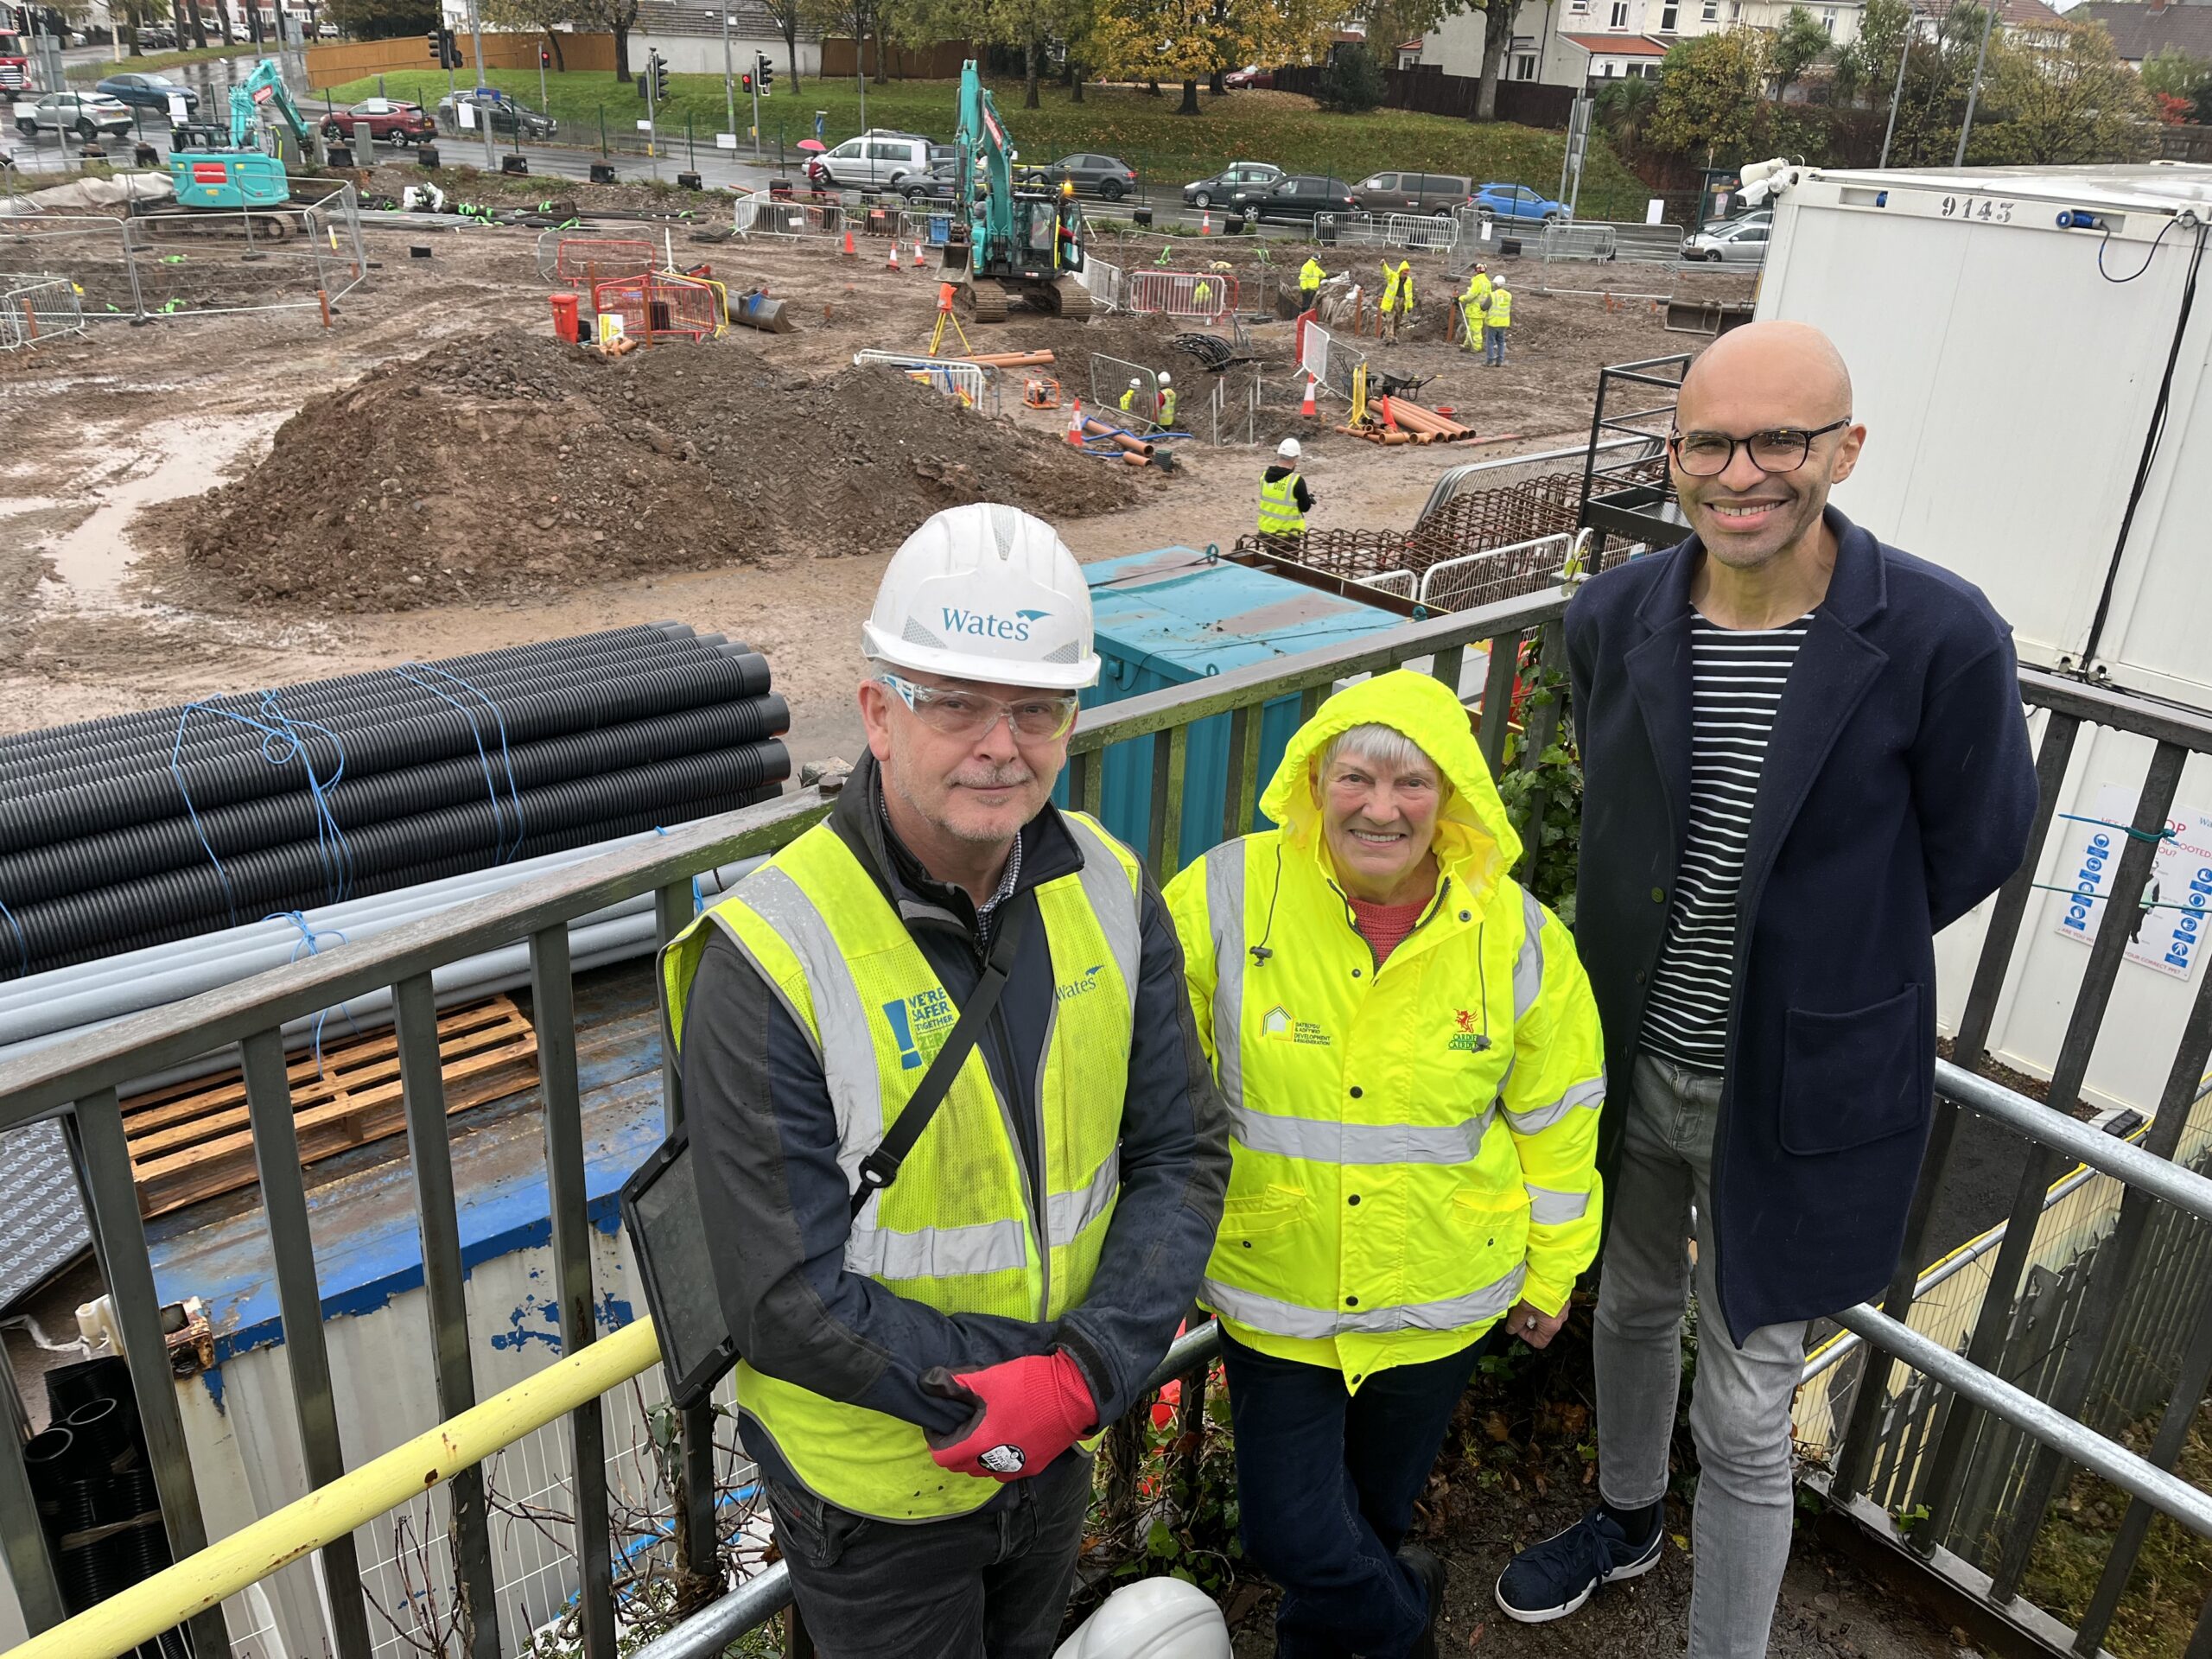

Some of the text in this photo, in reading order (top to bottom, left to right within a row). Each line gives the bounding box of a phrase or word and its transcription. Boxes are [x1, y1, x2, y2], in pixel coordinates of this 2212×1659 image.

[1942, 196, 2015, 224] 9143
[941, 607, 1029, 642] Wates
[2158, 847, 2177, 857] OU?
[2179, 842, 2212, 858] OOTED
[2140, 957, 2167, 969] CORRECT
[912, 1001, 951, 1022] SAFER
[1294, 1033, 1332, 1041] DEVELOPMENT
